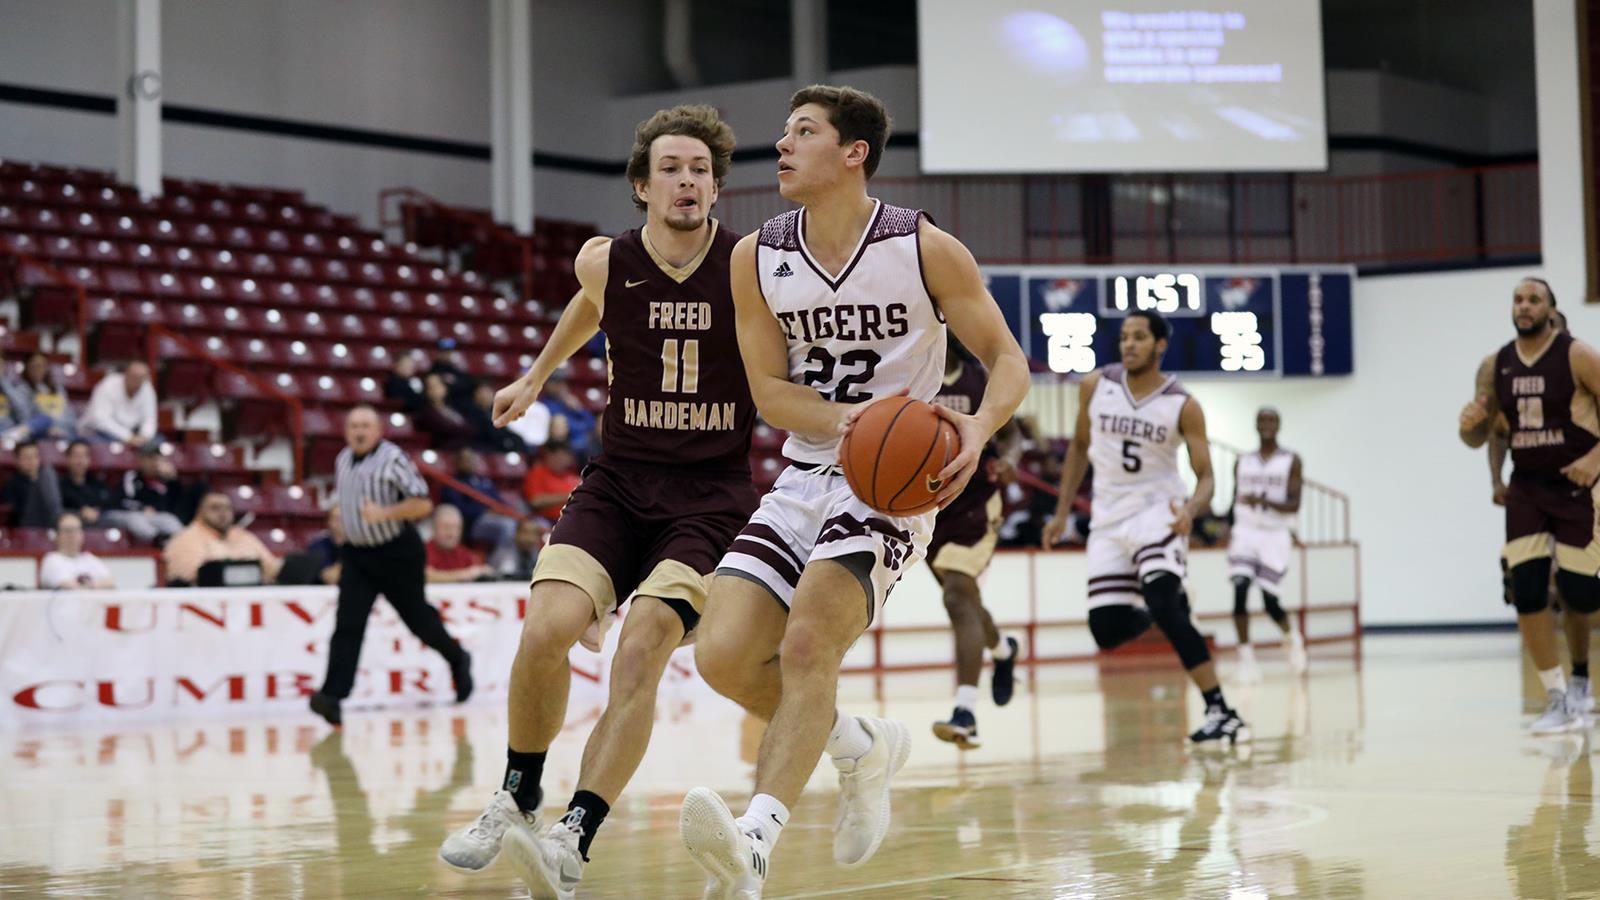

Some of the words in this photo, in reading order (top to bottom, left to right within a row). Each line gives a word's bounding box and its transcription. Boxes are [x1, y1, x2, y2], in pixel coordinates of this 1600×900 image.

[649, 301, 712, 331] FREED
[776, 302, 910, 343] TIGERS
[661, 338, 699, 394] 11
[804, 346, 882, 404] 22
[624, 397, 736, 431] HARDEMAN
[1098, 413, 1168, 444] TIGERS
[1122, 440, 1143, 474] 5
